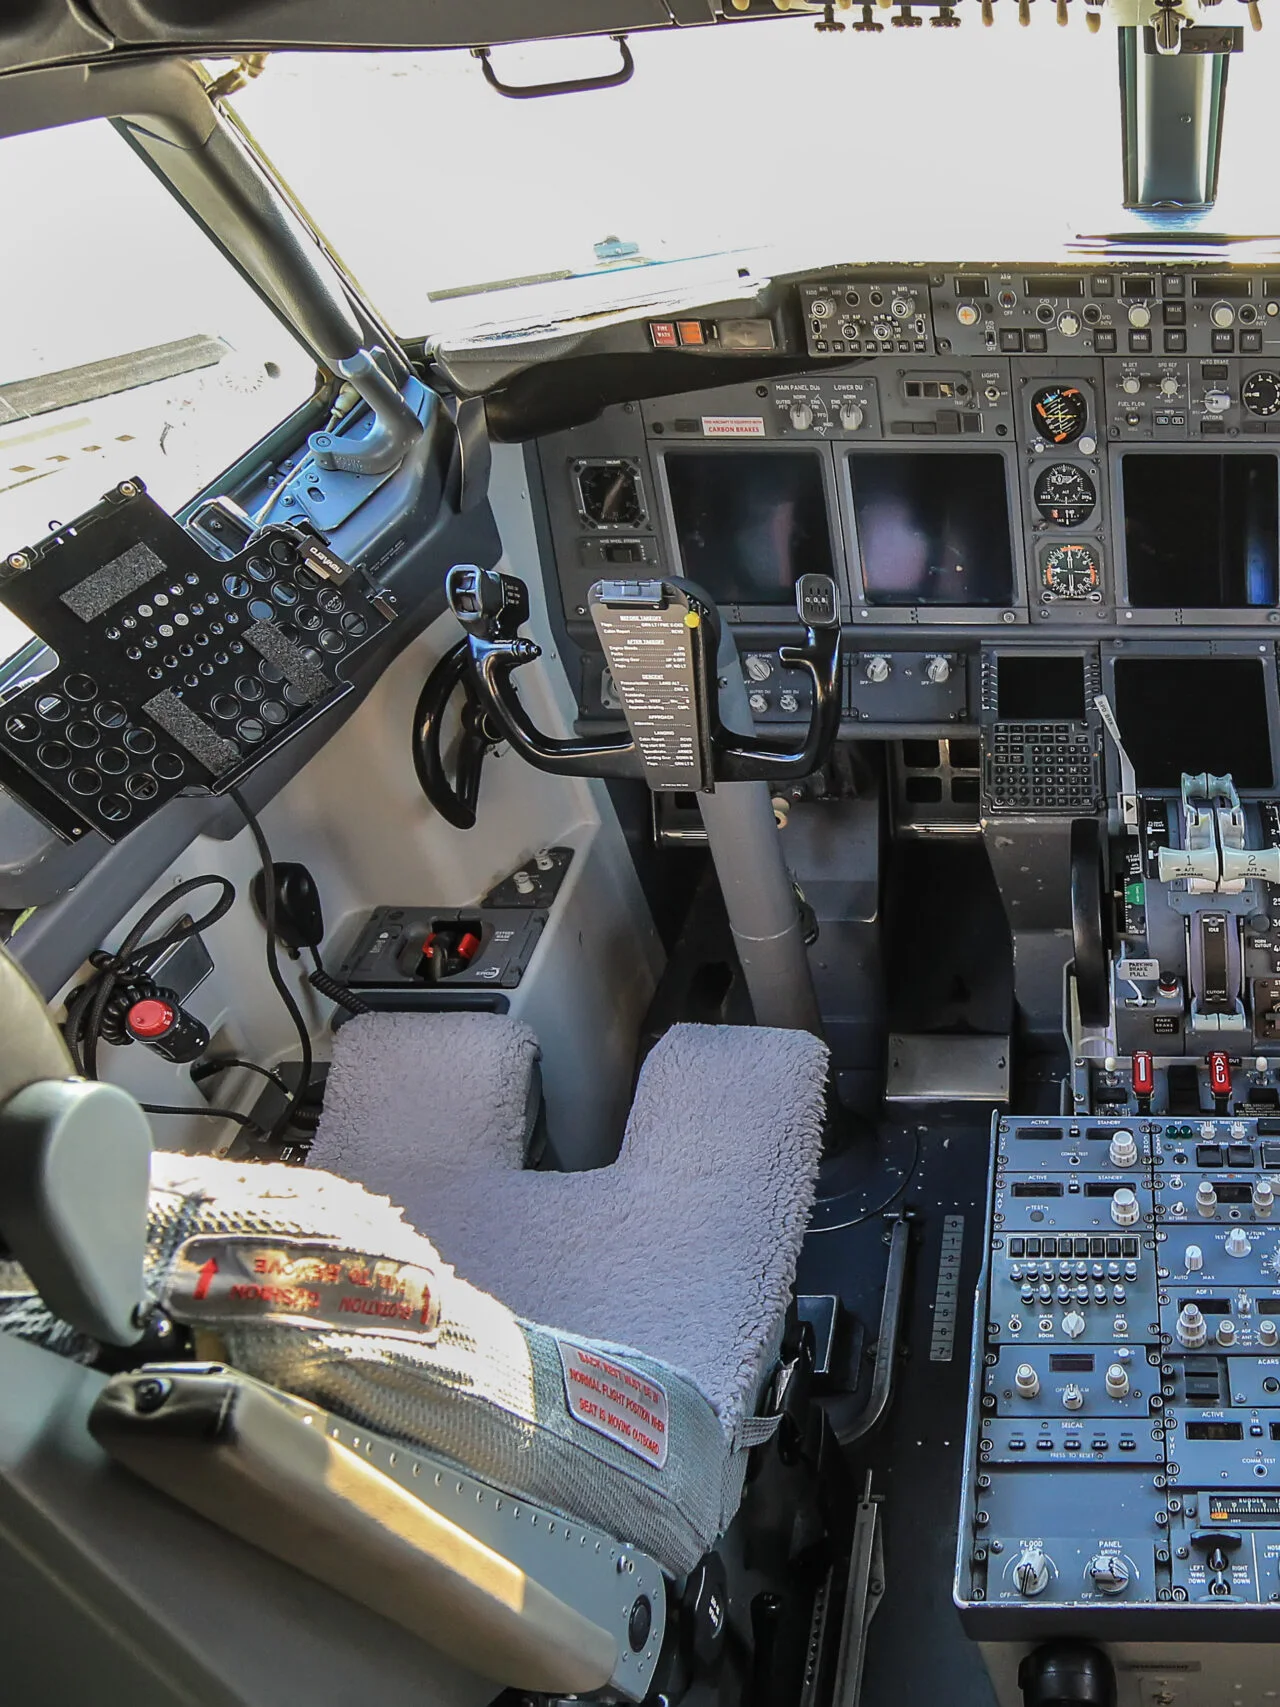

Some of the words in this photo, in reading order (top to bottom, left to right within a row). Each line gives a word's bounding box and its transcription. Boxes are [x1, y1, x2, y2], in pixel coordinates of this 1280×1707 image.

[1248, 855, 1256, 865] 2
[1138, 1057, 1146, 1082] 1
[1215, 1057, 1225, 1082] APU
[254, 1258, 342, 1283] REMOVE
[348, 1265, 370, 1288] TO
[230, 1283, 321, 1309] CUSHION
[338, 1296, 414, 1320] FLOTATION
[578, 1352, 600, 1368] BACK
[603, 1362, 621, 1379] REST
[624, 1375, 641, 1392] MUST
[570, 1368, 601, 1393] NORMAL
[602, 1384, 625, 1405] FLIGHT
[626, 1398, 650, 1422] POSITION
[651, 1414, 665, 1433] WHEN
[580, 1398, 598, 1416] SEAT
[600, 1408, 606, 1421] IS
[608, 1413, 631, 1436] MOVING
[632, 1428, 659, 1455] OUTBOARD
